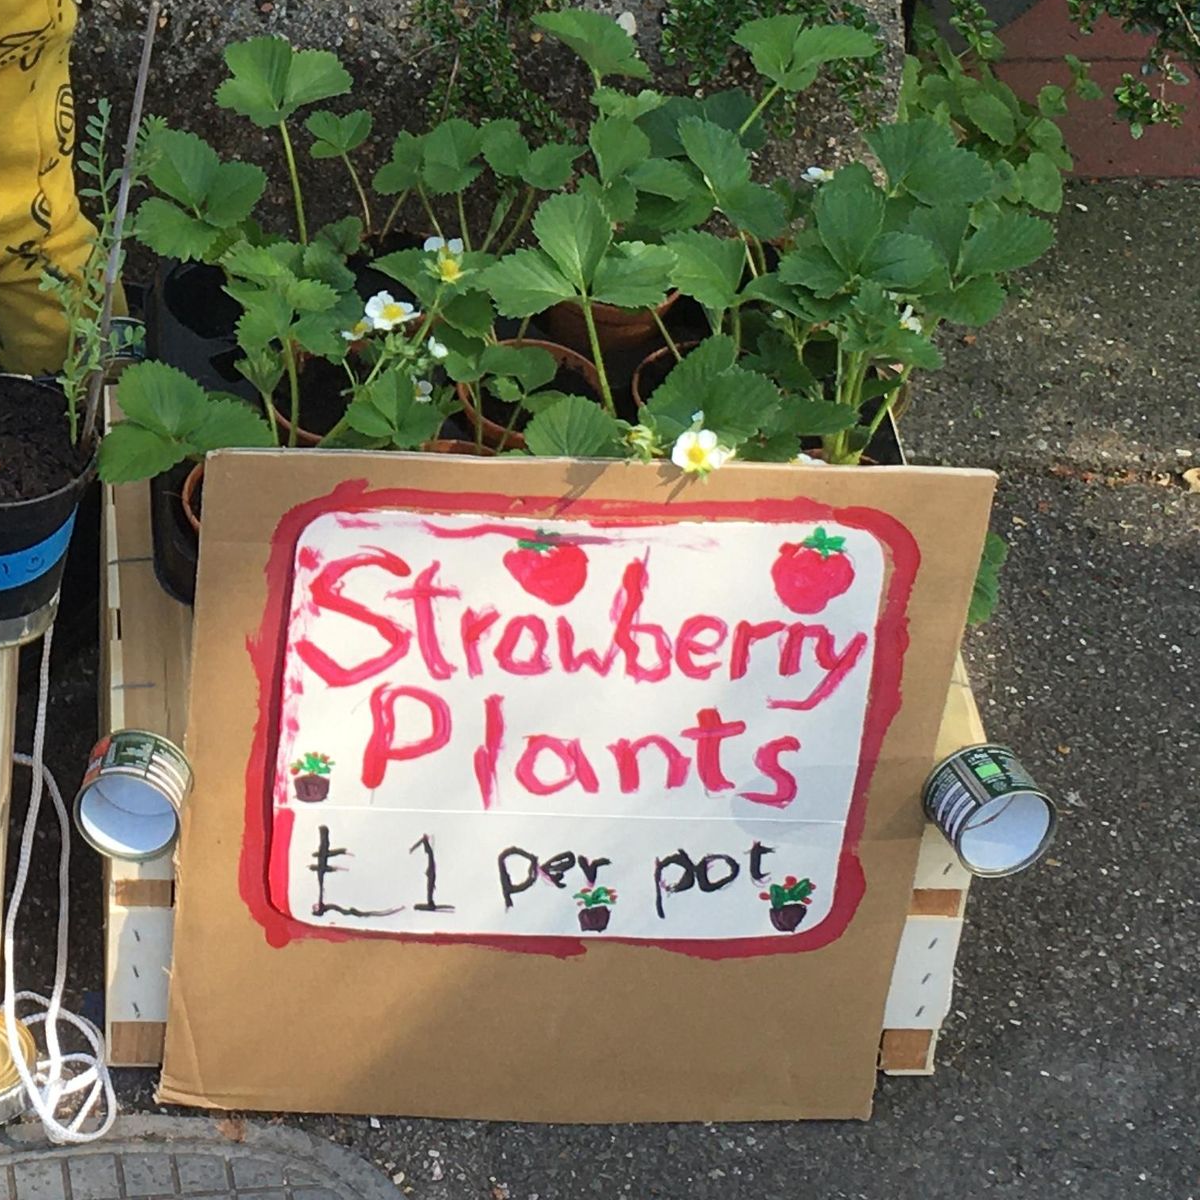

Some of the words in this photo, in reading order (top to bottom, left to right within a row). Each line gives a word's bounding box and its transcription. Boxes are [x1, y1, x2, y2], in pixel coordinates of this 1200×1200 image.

[295, 544, 868, 711] Strawberry
[360, 682, 801, 810] Plants
[498, 845, 613, 913] per
[654, 840, 777, 920] pot
